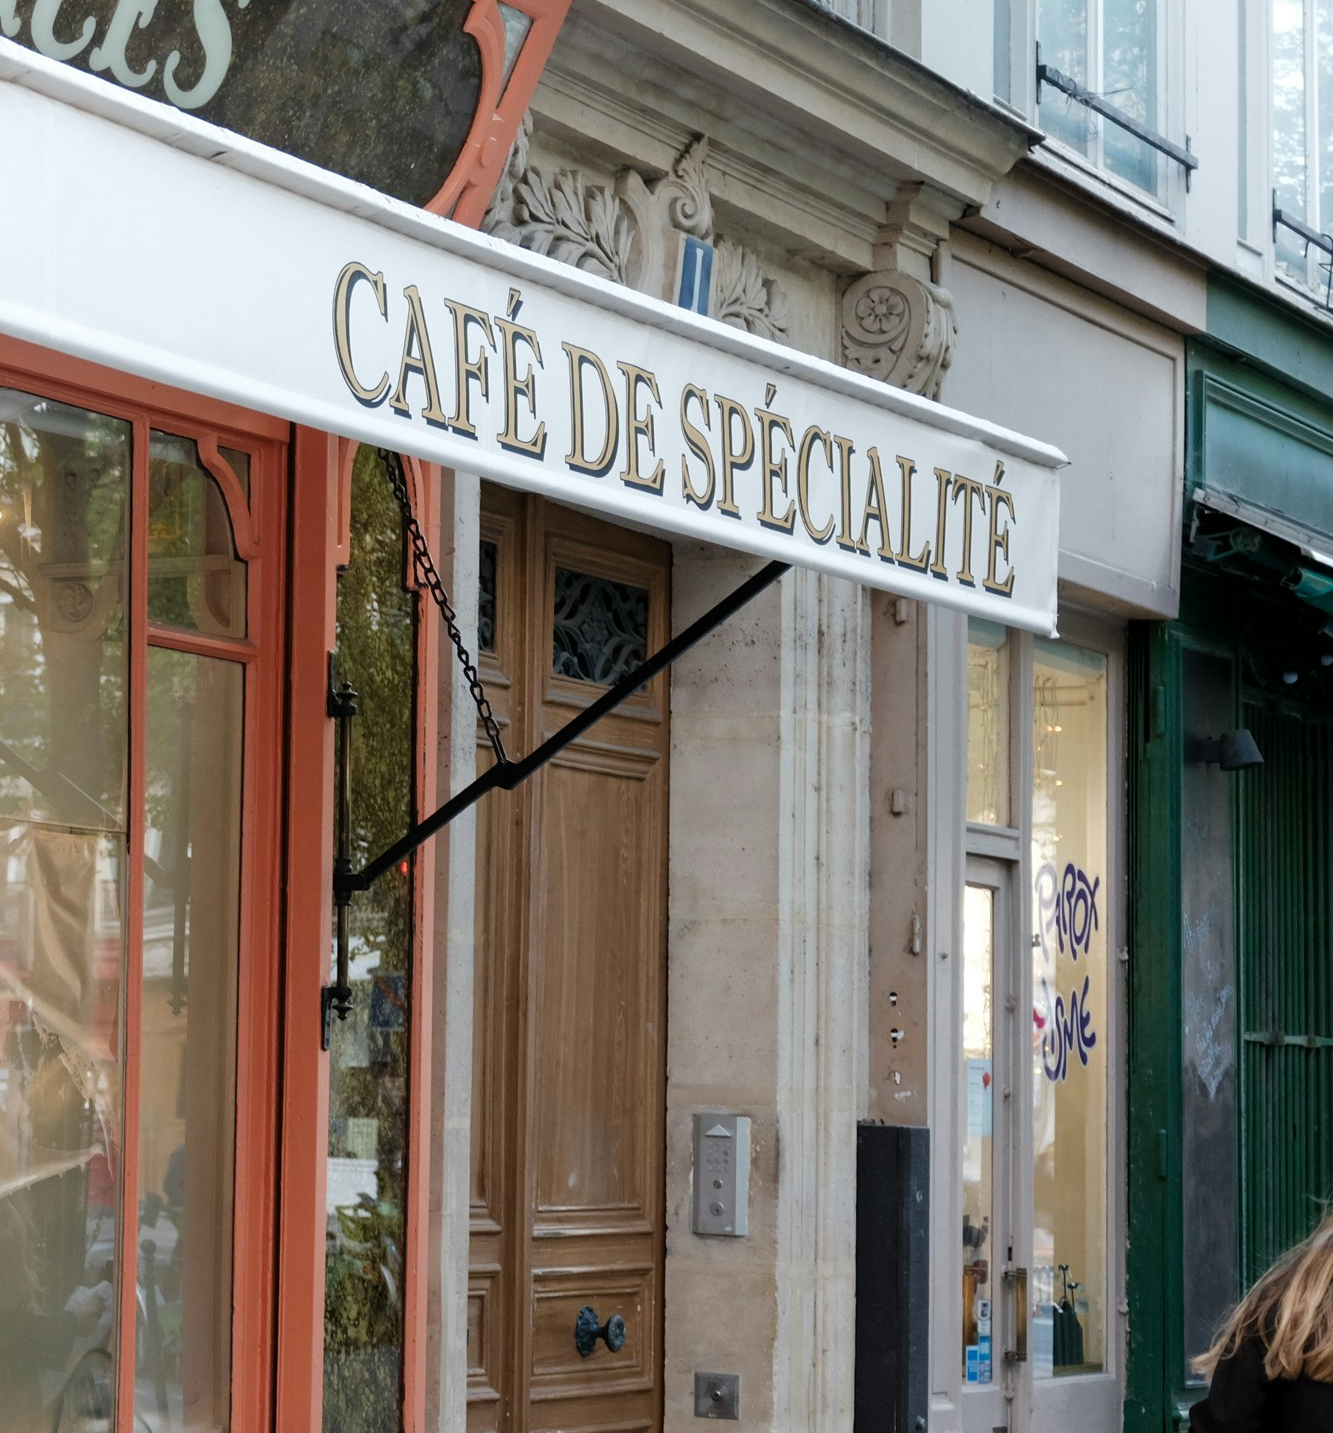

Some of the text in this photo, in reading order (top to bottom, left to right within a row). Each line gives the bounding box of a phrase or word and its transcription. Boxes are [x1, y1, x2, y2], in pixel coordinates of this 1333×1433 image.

[331, 261, 1017, 597] CAFÉ DE SPÉCIALITÉ
